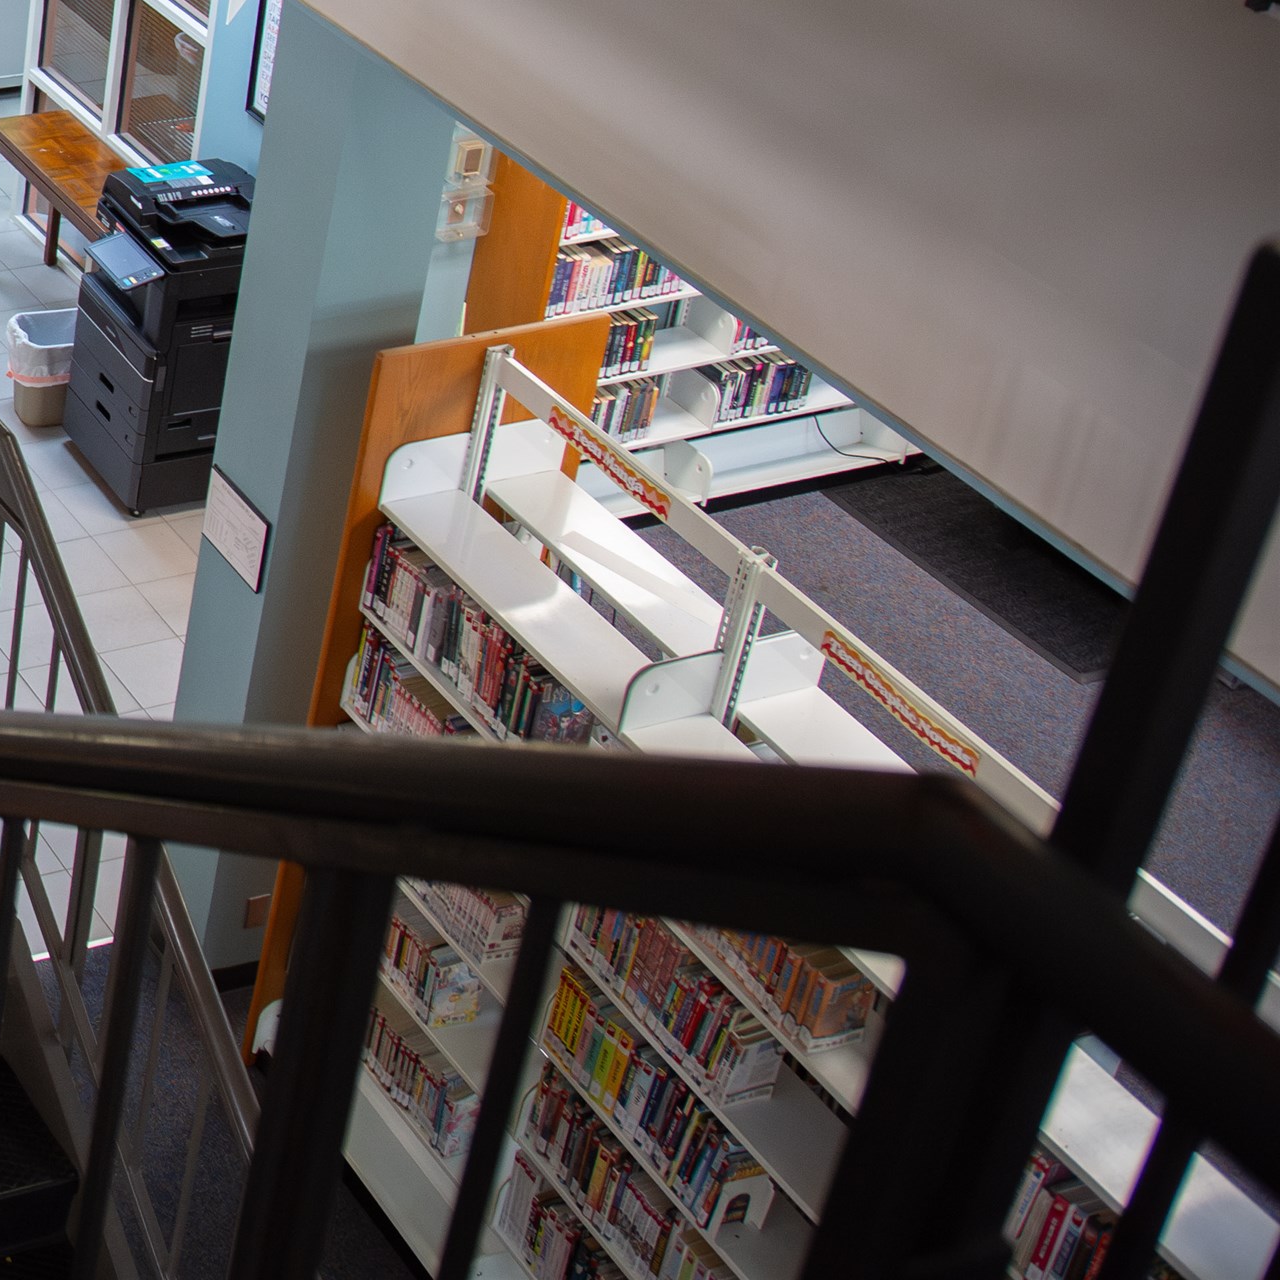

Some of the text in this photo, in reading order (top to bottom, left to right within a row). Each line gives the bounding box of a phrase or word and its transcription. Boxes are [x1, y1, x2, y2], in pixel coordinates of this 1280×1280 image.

[571, 424, 645, 496] Teen Manga
[829, 636, 974, 766] Teen Graphic Novels
